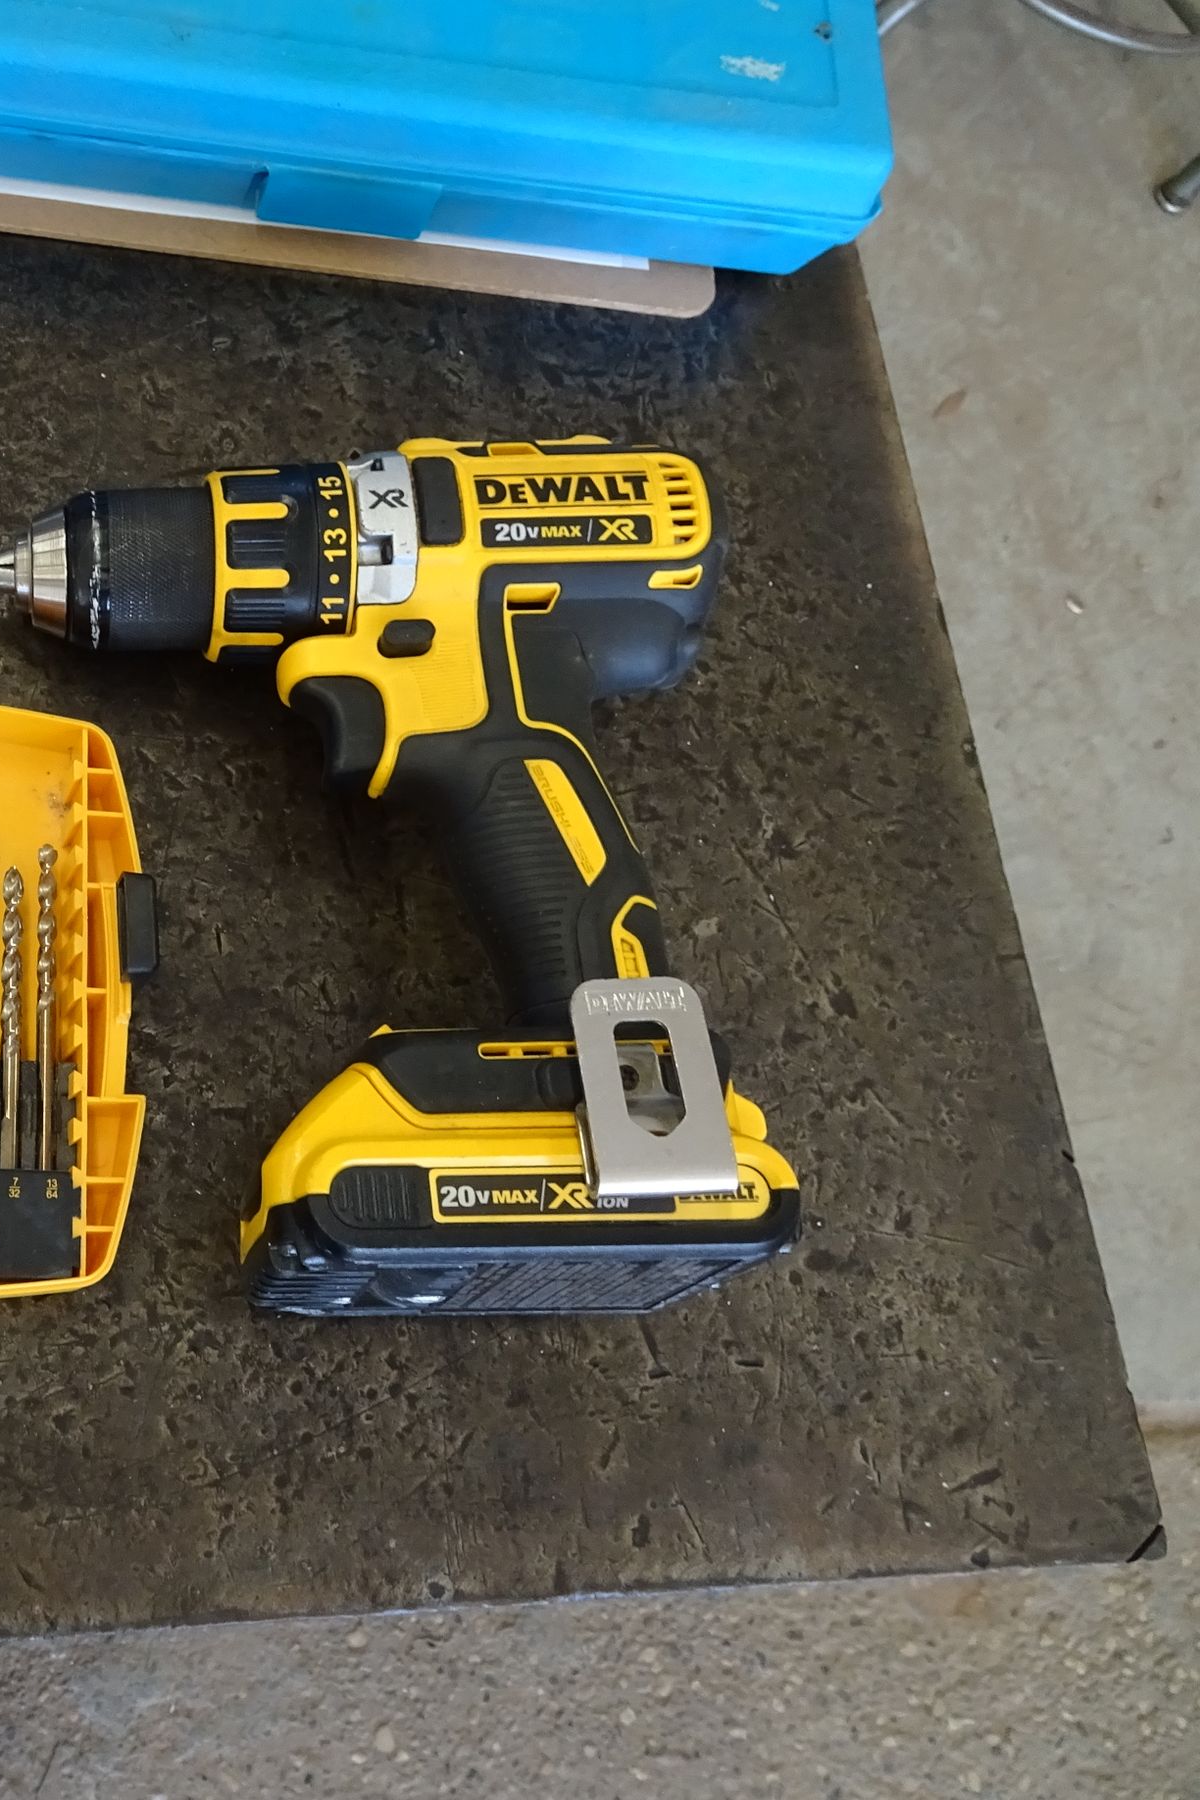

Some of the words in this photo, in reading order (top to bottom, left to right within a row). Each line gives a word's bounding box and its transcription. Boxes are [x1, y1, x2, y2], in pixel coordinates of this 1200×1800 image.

[318, 476, 343, 500] 15
[368, 487, 409, 510] XR
[473, 475, 650, 505] DEWALT
[540, 524, 583, 539] MAX
[597, 518, 639, 541] XR
[323, 527, 347, 562] 13
[320, 597, 345, 625] 11
[491, 1188, 538, 1204] MAX
[547, 1181, 593, 1209] XR
